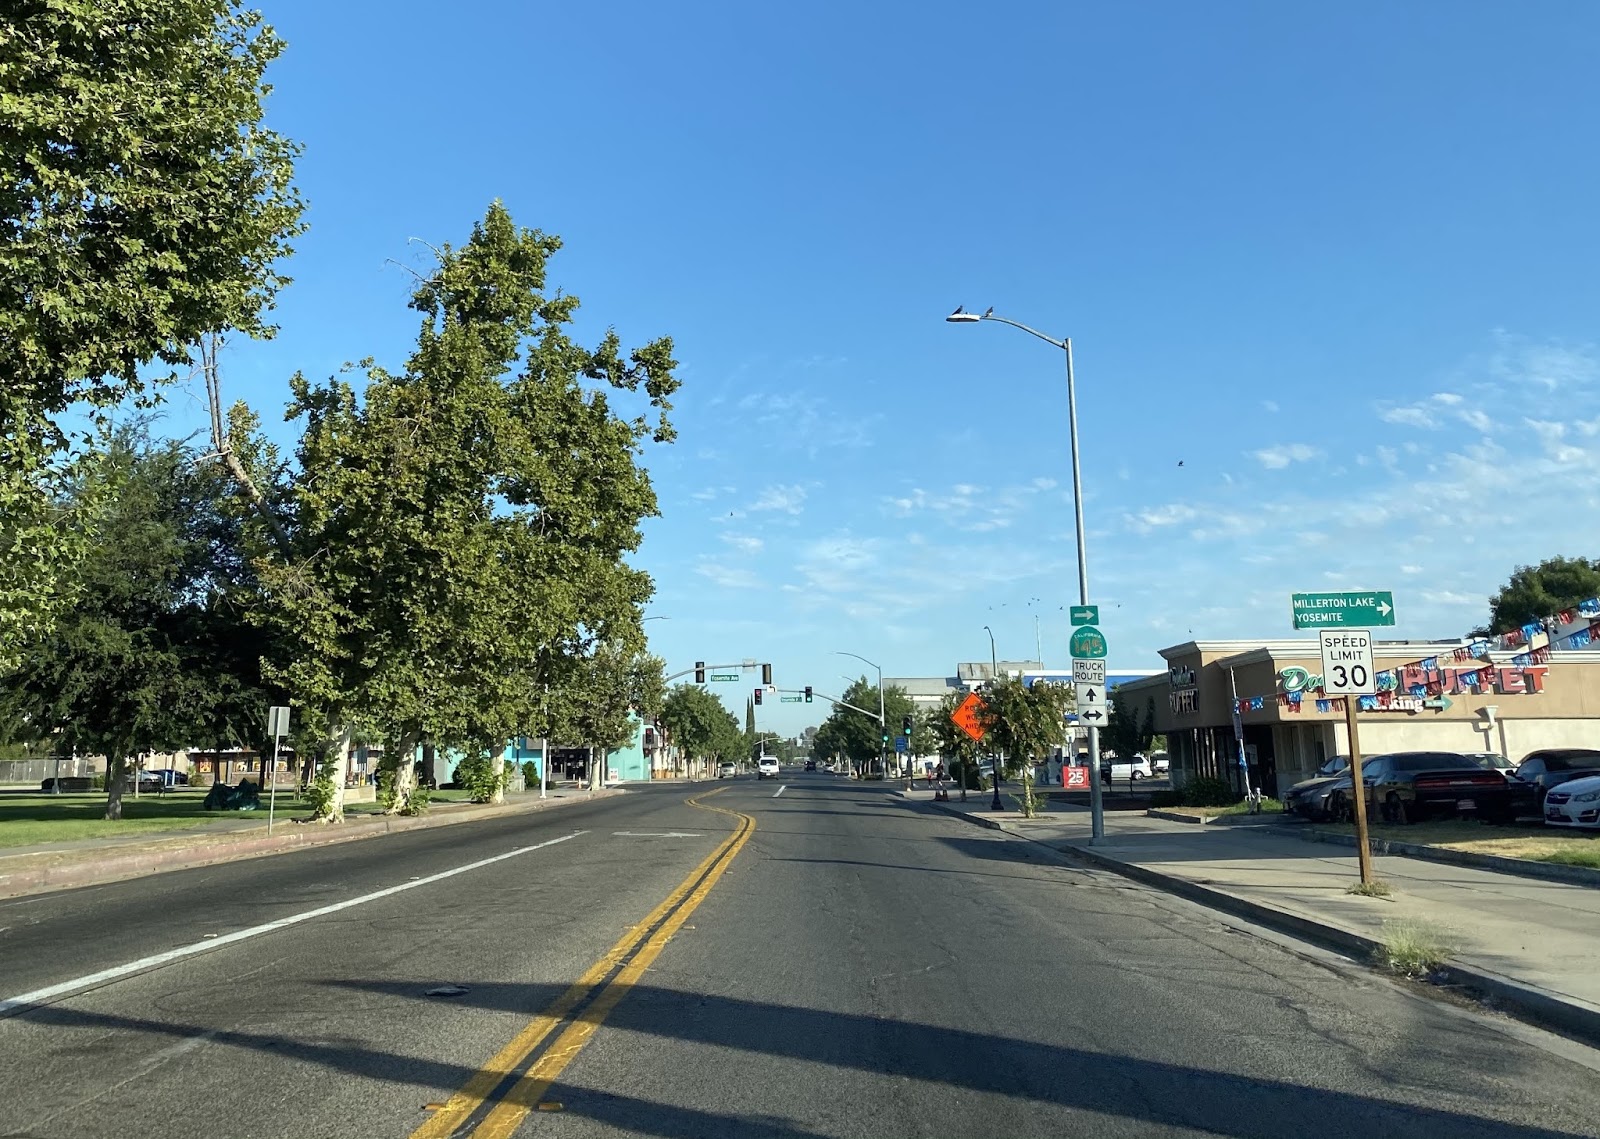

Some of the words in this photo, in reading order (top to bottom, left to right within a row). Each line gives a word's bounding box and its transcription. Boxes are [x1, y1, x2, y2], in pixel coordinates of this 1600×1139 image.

[1294, 599, 1347, 609] MILLERTON
[1348, 598, 1376, 607] LAKE
[1296, 612, 1344, 622] YOSEMITE
[1074, 637, 1103, 657] 145
[1325, 638, 1367, 647] SPEED
[1330, 651, 1364, 660] LIMIT
[1075, 662, 1103, 670] TRUCK
[1075, 672, 1103, 681] ROUTE
[1332, 665, 1367, 688] 30
[1068, 772, 1084, 784] 25
